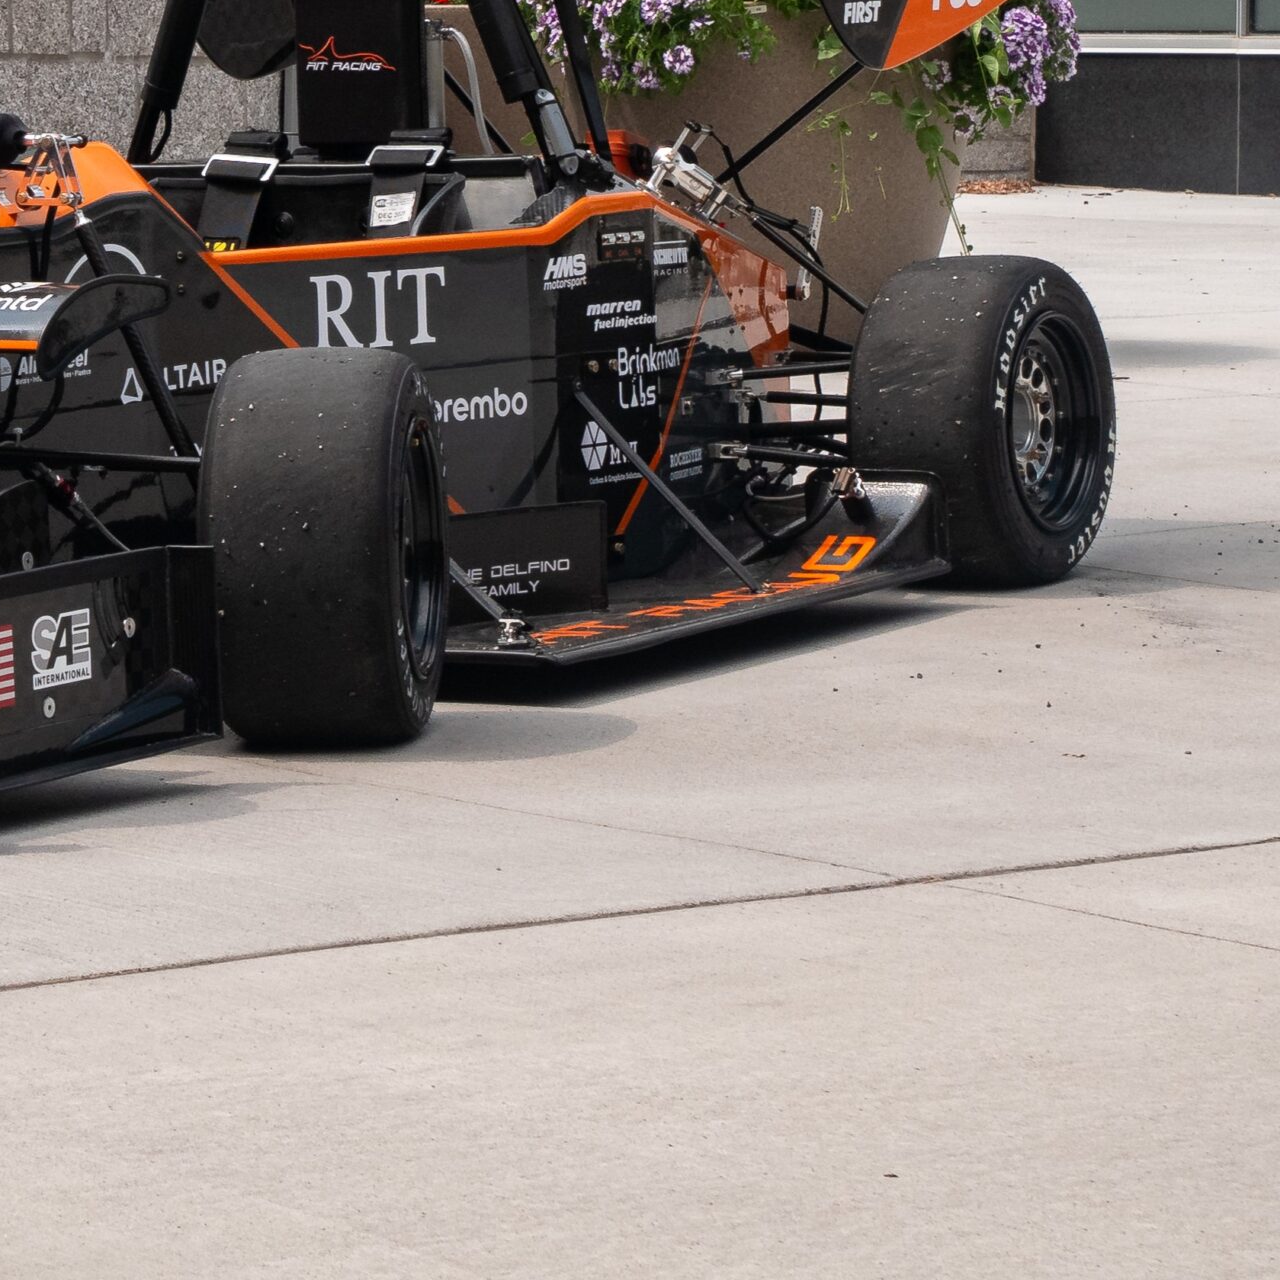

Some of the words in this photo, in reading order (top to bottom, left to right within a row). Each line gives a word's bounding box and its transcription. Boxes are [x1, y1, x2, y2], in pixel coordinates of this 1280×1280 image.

[843, 0, 881, 24] FIRST
[306, 62, 329, 71] RIT
[332, 62, 382, 71] RACING
[544, 253, 587, 280] HMS
[653, 268, 689, 276] RACING
[543, 277, 587, 291] motorsport
[309, 266, 445, 348] RIT
[586, 300, 641, 316] marren
[995, 276, 1047, 418] Hoosier
[617, 343, 680, 376] Brinkman
[163, 358, 226, 391] LTAIR
[490, 558, 570, 578] DELFINO
[31, 608, 91, 673] SAE
[34, 667, 90, 687] INTERNATIONAL
